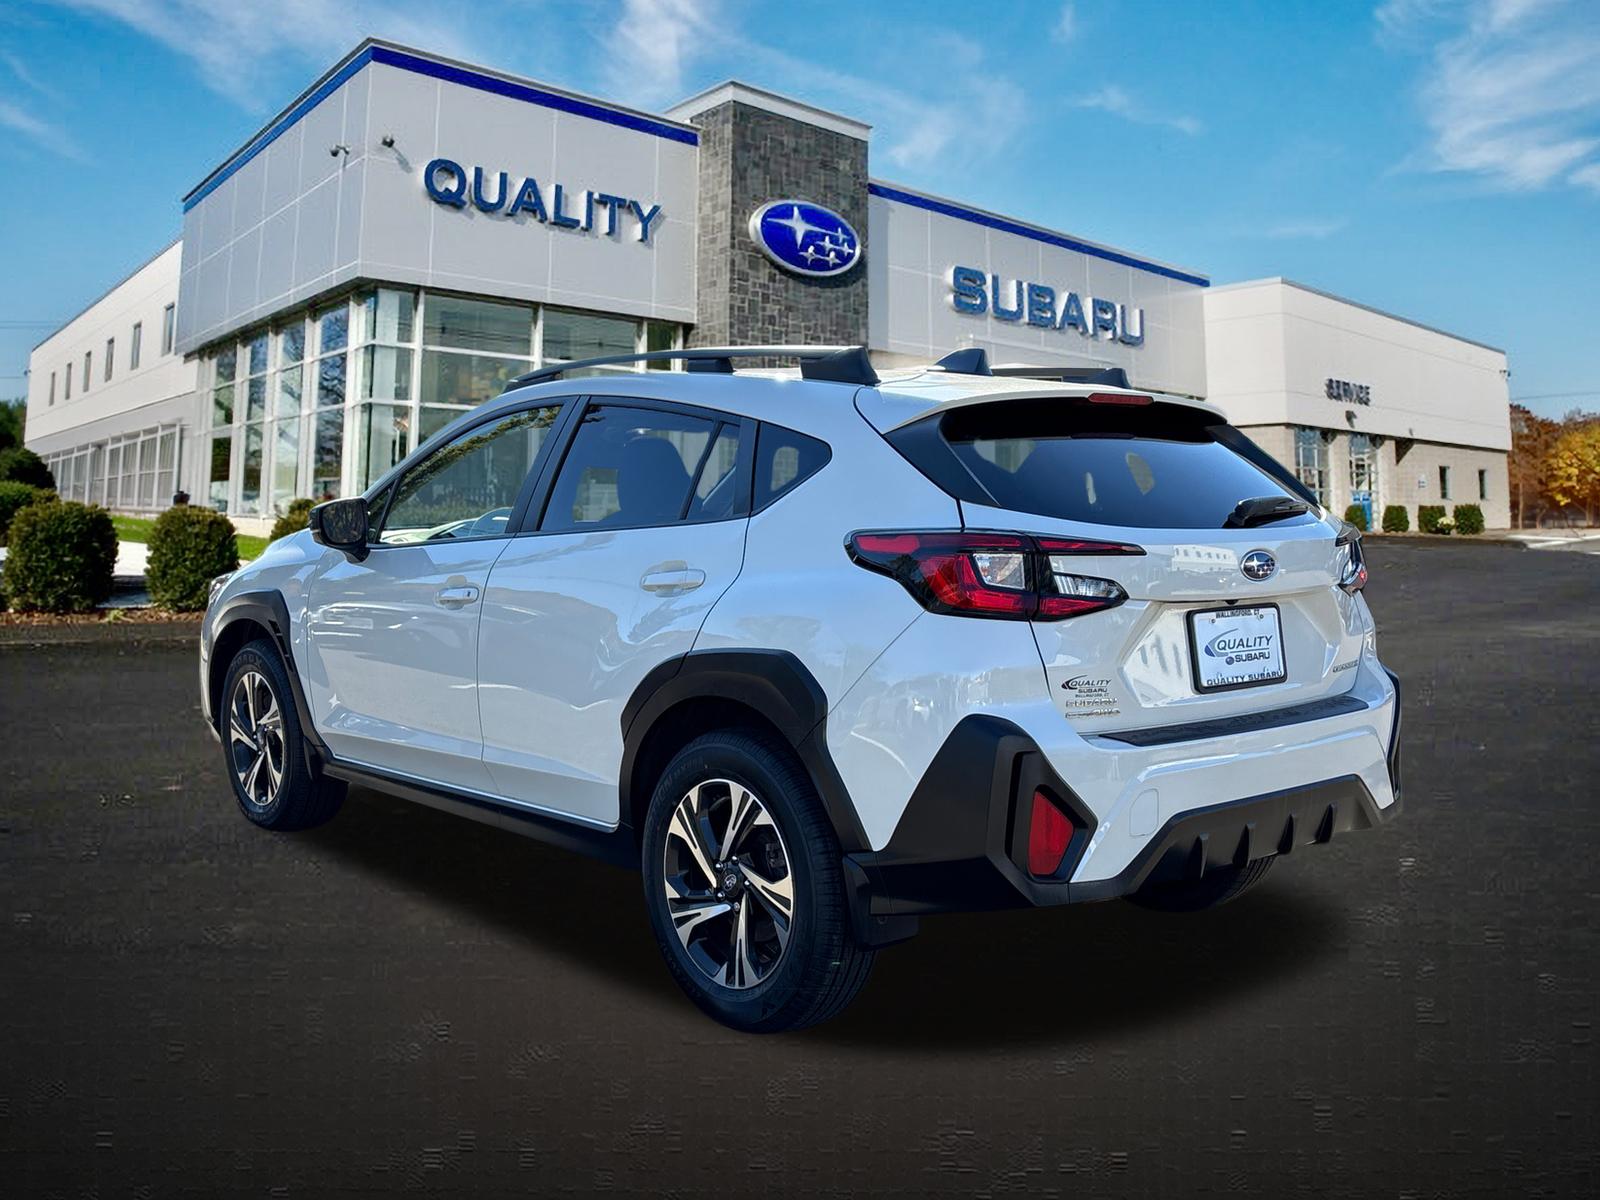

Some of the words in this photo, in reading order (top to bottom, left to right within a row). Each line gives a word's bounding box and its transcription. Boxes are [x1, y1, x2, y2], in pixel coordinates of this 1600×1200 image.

[424, 158, 661, 243] QUALITY
[949, 265, 1145, 347] SUBARU
[1217, 635, 1273, 650] QUALITY
[1234, 652, 1270, 662] SUBARU
[1206, 674, 1247, 686] QUALITY
[1248, 669, 1283, 681] SUBARU
